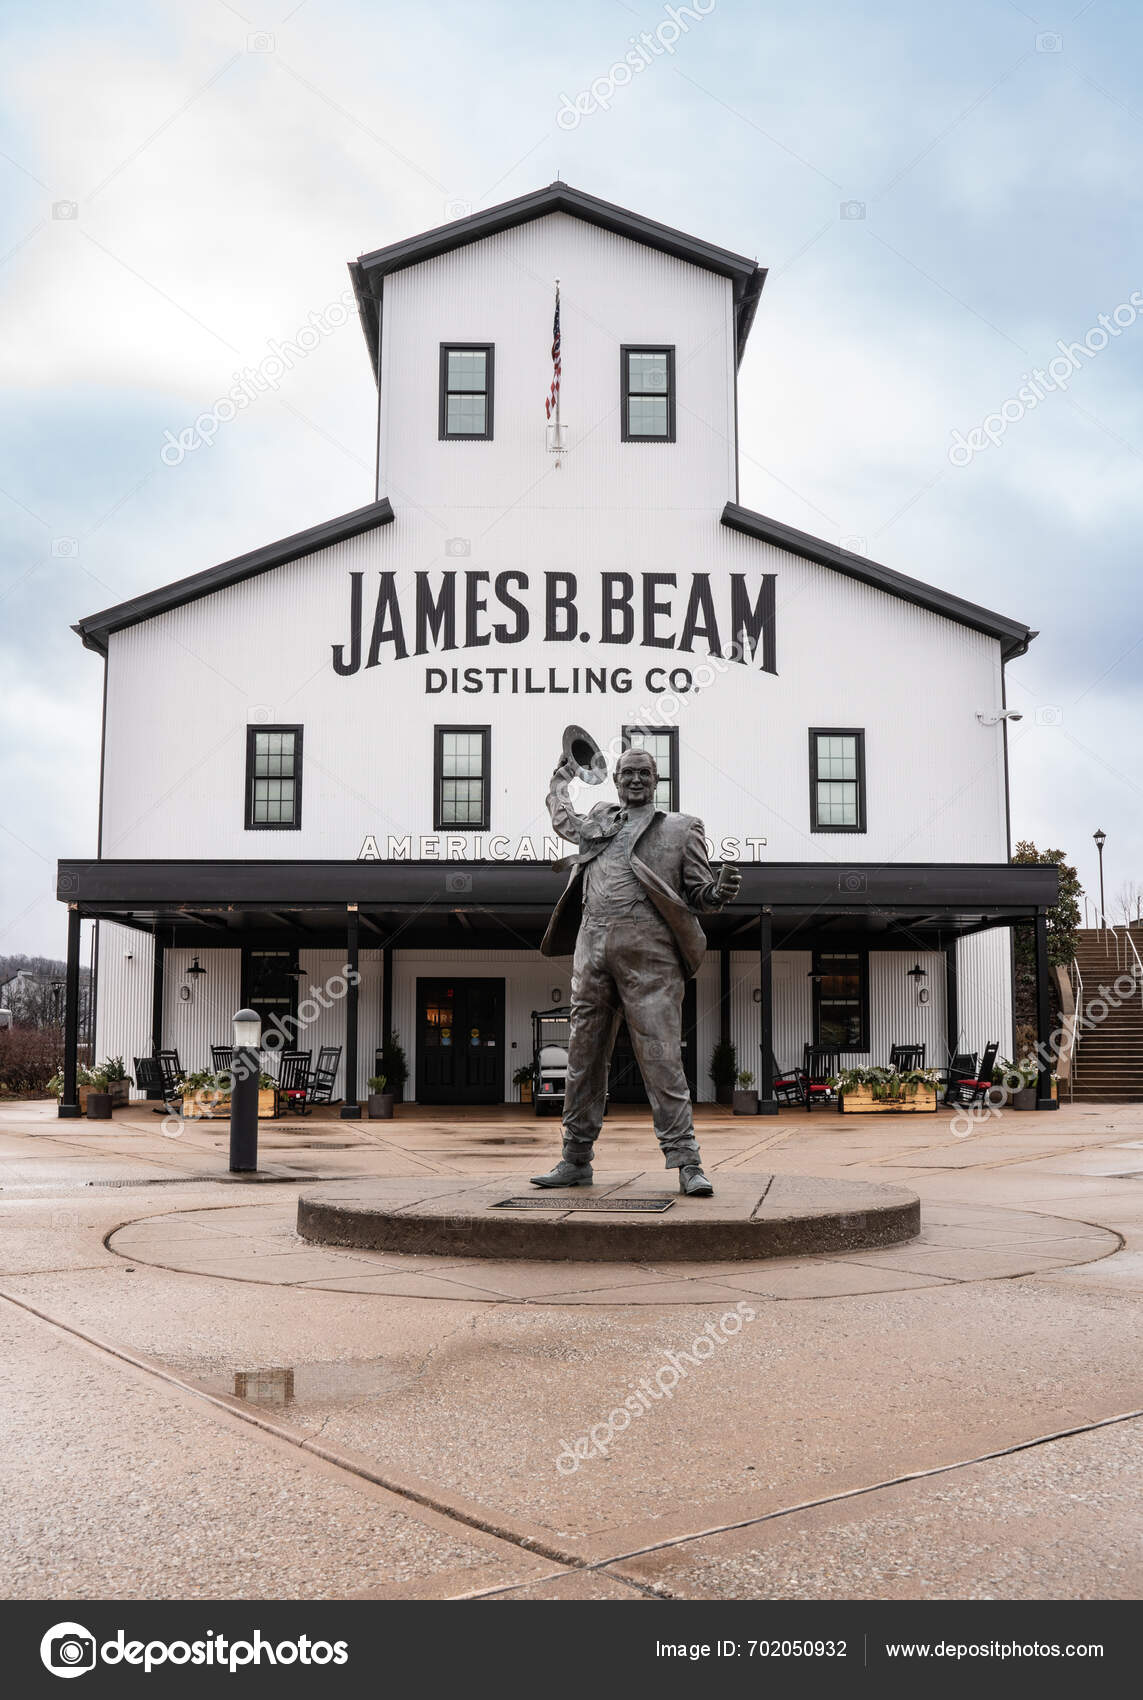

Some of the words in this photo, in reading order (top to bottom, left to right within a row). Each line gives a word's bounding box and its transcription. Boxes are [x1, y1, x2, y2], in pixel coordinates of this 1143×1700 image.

[331, 570, 530, 676] JAMES
[543, 571, 590, 643] B.
[599, 571, 779, 676] BEAM
[425, 667, 633, 694] DISTILLING
[645, 667, 700, 694] CO.
[356, 835, 564, 861] AMERICAN
